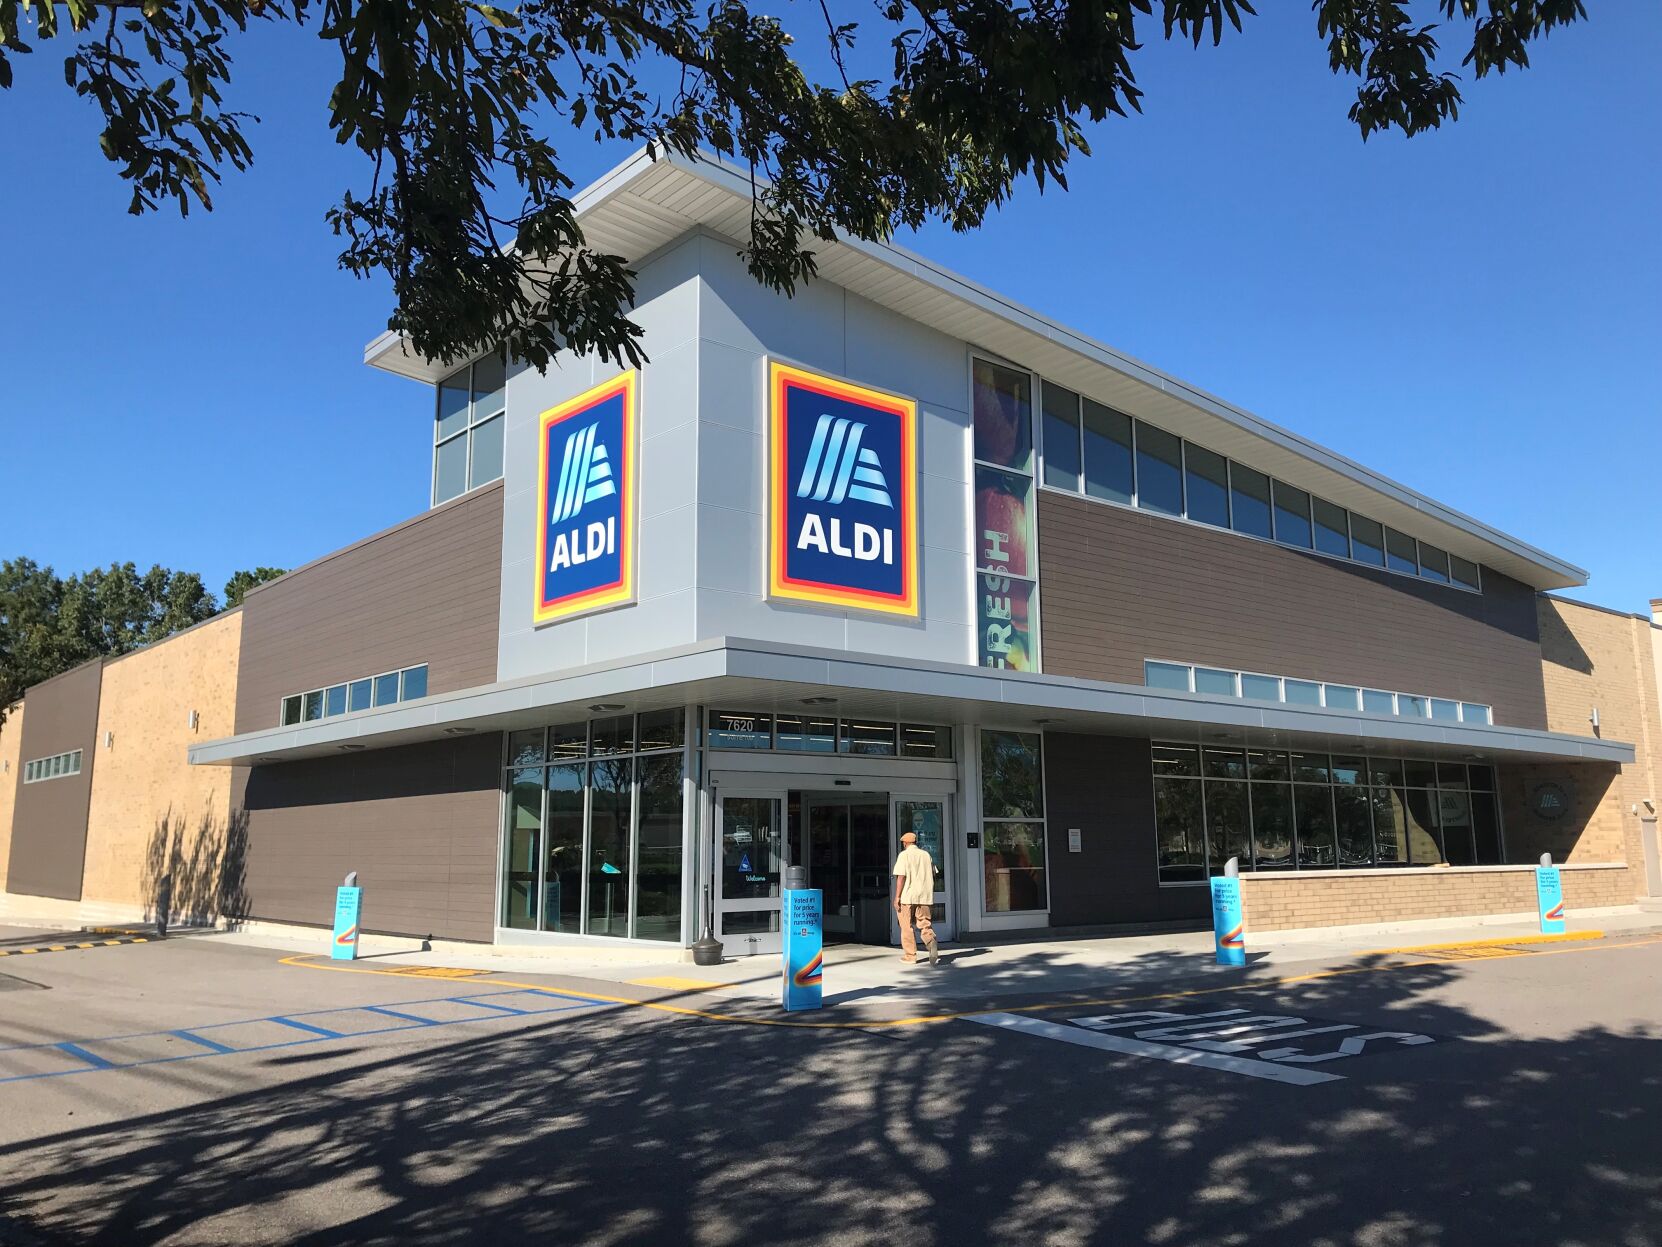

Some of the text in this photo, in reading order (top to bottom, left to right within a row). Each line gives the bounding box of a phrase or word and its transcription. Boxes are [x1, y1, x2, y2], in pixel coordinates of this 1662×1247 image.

[550, 516, 615, 573] ALDI
[797, 513, 893, 565] ALDI
[726, 719, 754, 732] 7620
[745, 874, 766, 882] Welcome
[1067, 1008, 1435, 1063] STOP
